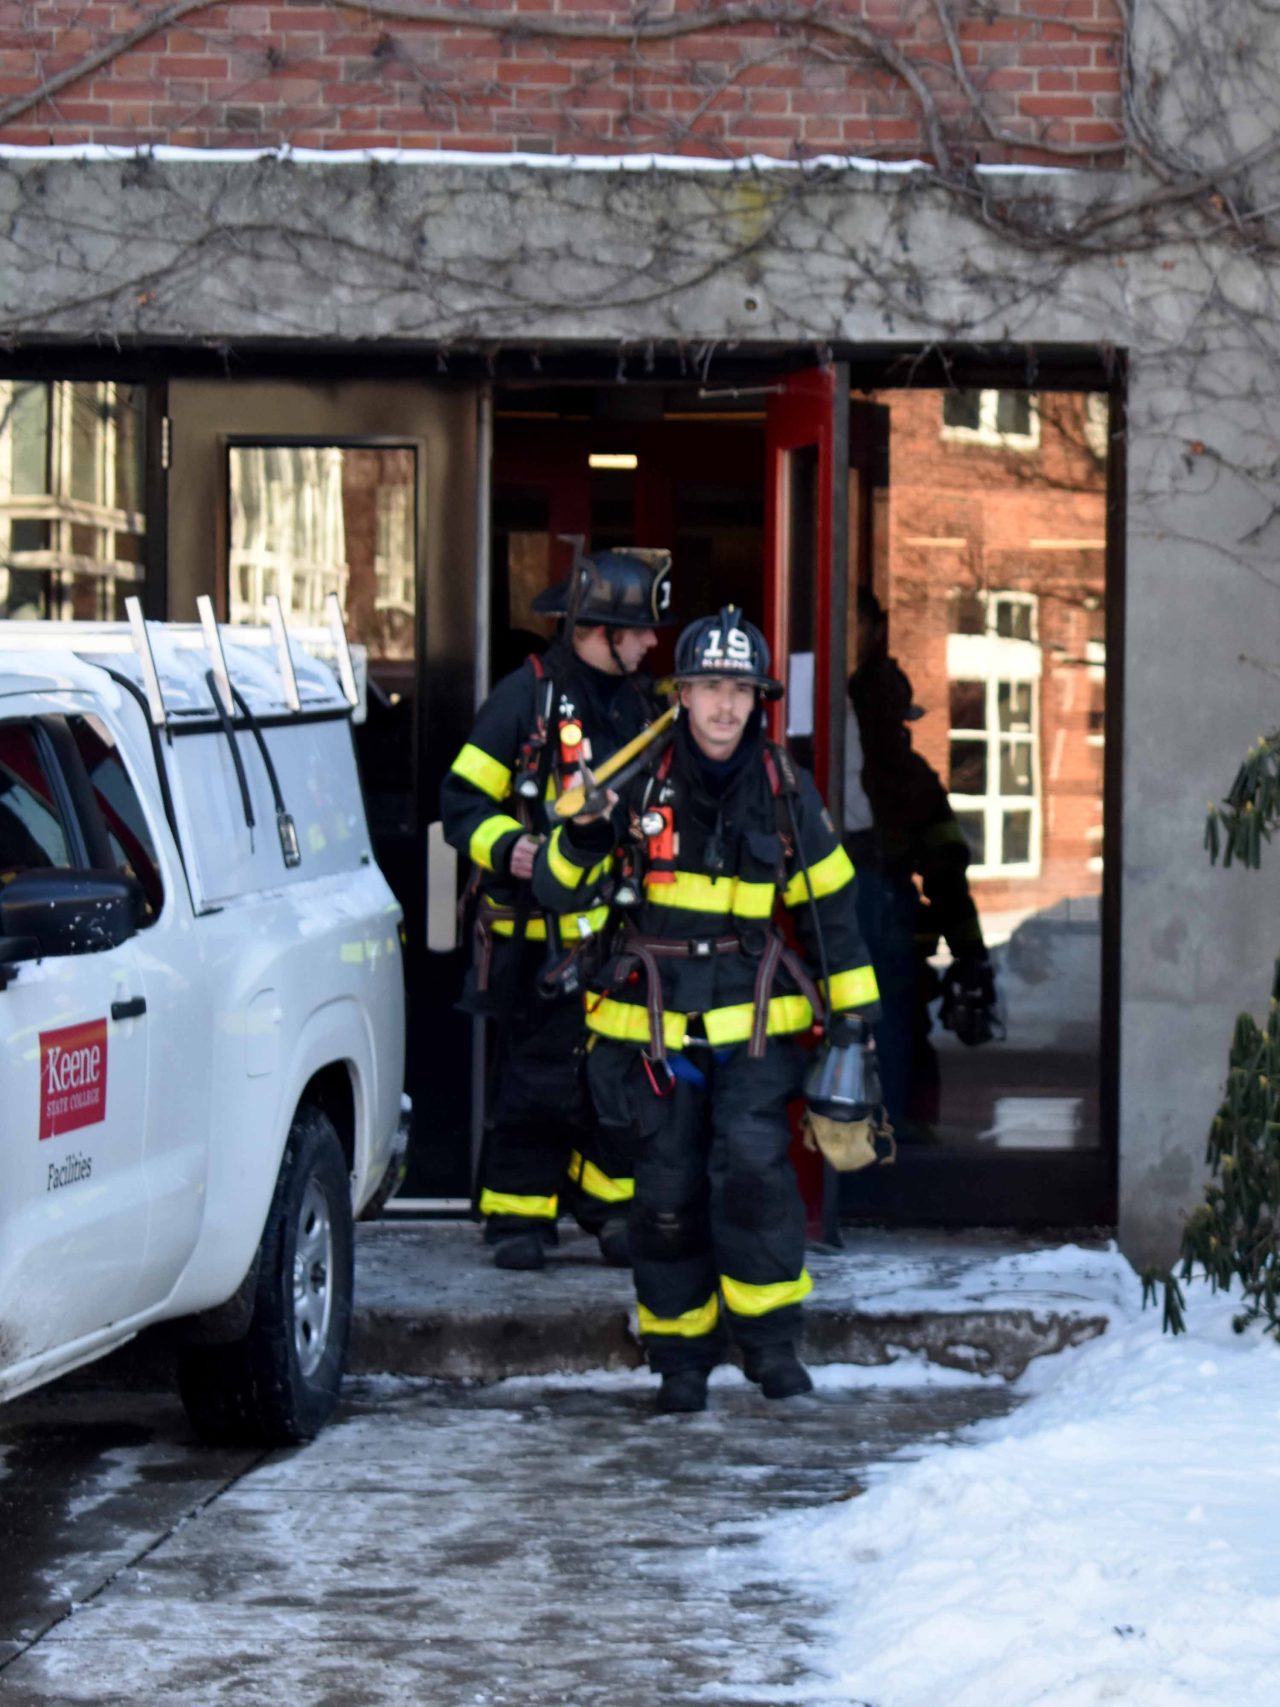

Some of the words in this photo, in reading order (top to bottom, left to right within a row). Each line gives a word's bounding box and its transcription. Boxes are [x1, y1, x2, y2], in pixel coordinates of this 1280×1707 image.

[703, 627, 751, 660] 19
[46, 1044, 100, 1095] Keene
[46, 1097, 69, 1118] STATE
[47, 1151, 93, 1192] Facilities
